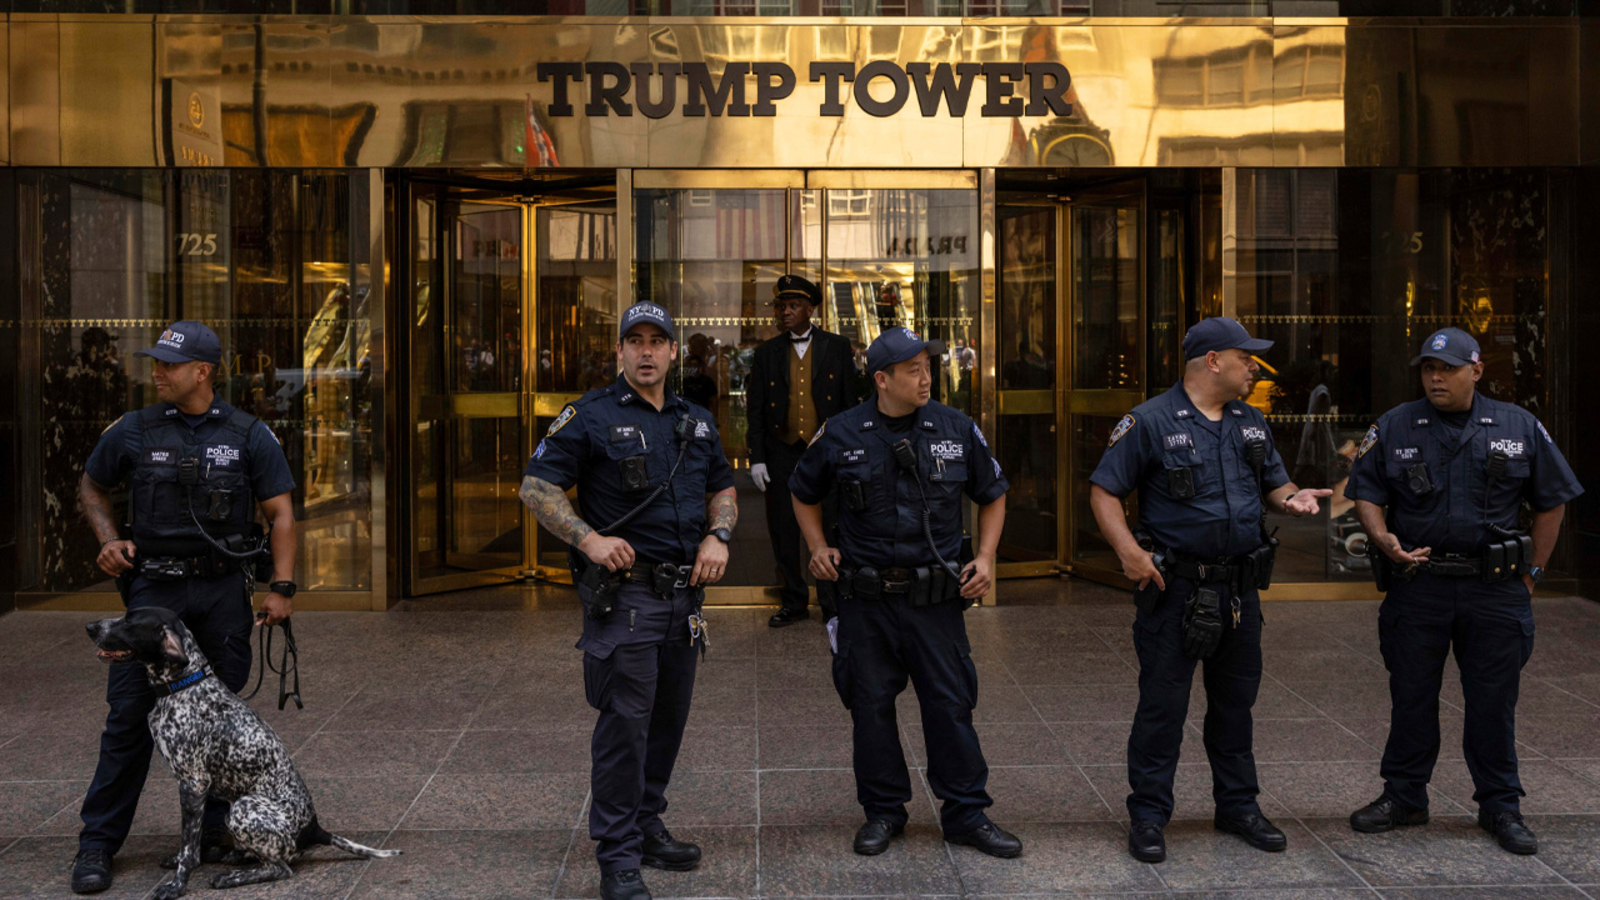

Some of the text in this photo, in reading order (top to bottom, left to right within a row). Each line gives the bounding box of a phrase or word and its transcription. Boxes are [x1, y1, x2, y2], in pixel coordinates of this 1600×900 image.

[537, 60, 1073, 119] TRUMP TOWER
[177, 233, 217, 256] 725
[1243, 428, 1266, 440] POLICE
[930, 444, 963, 453] POLICE
[1490, 441, 1524, 451] POLICE
[206, 448, 239, 457] POLICE
